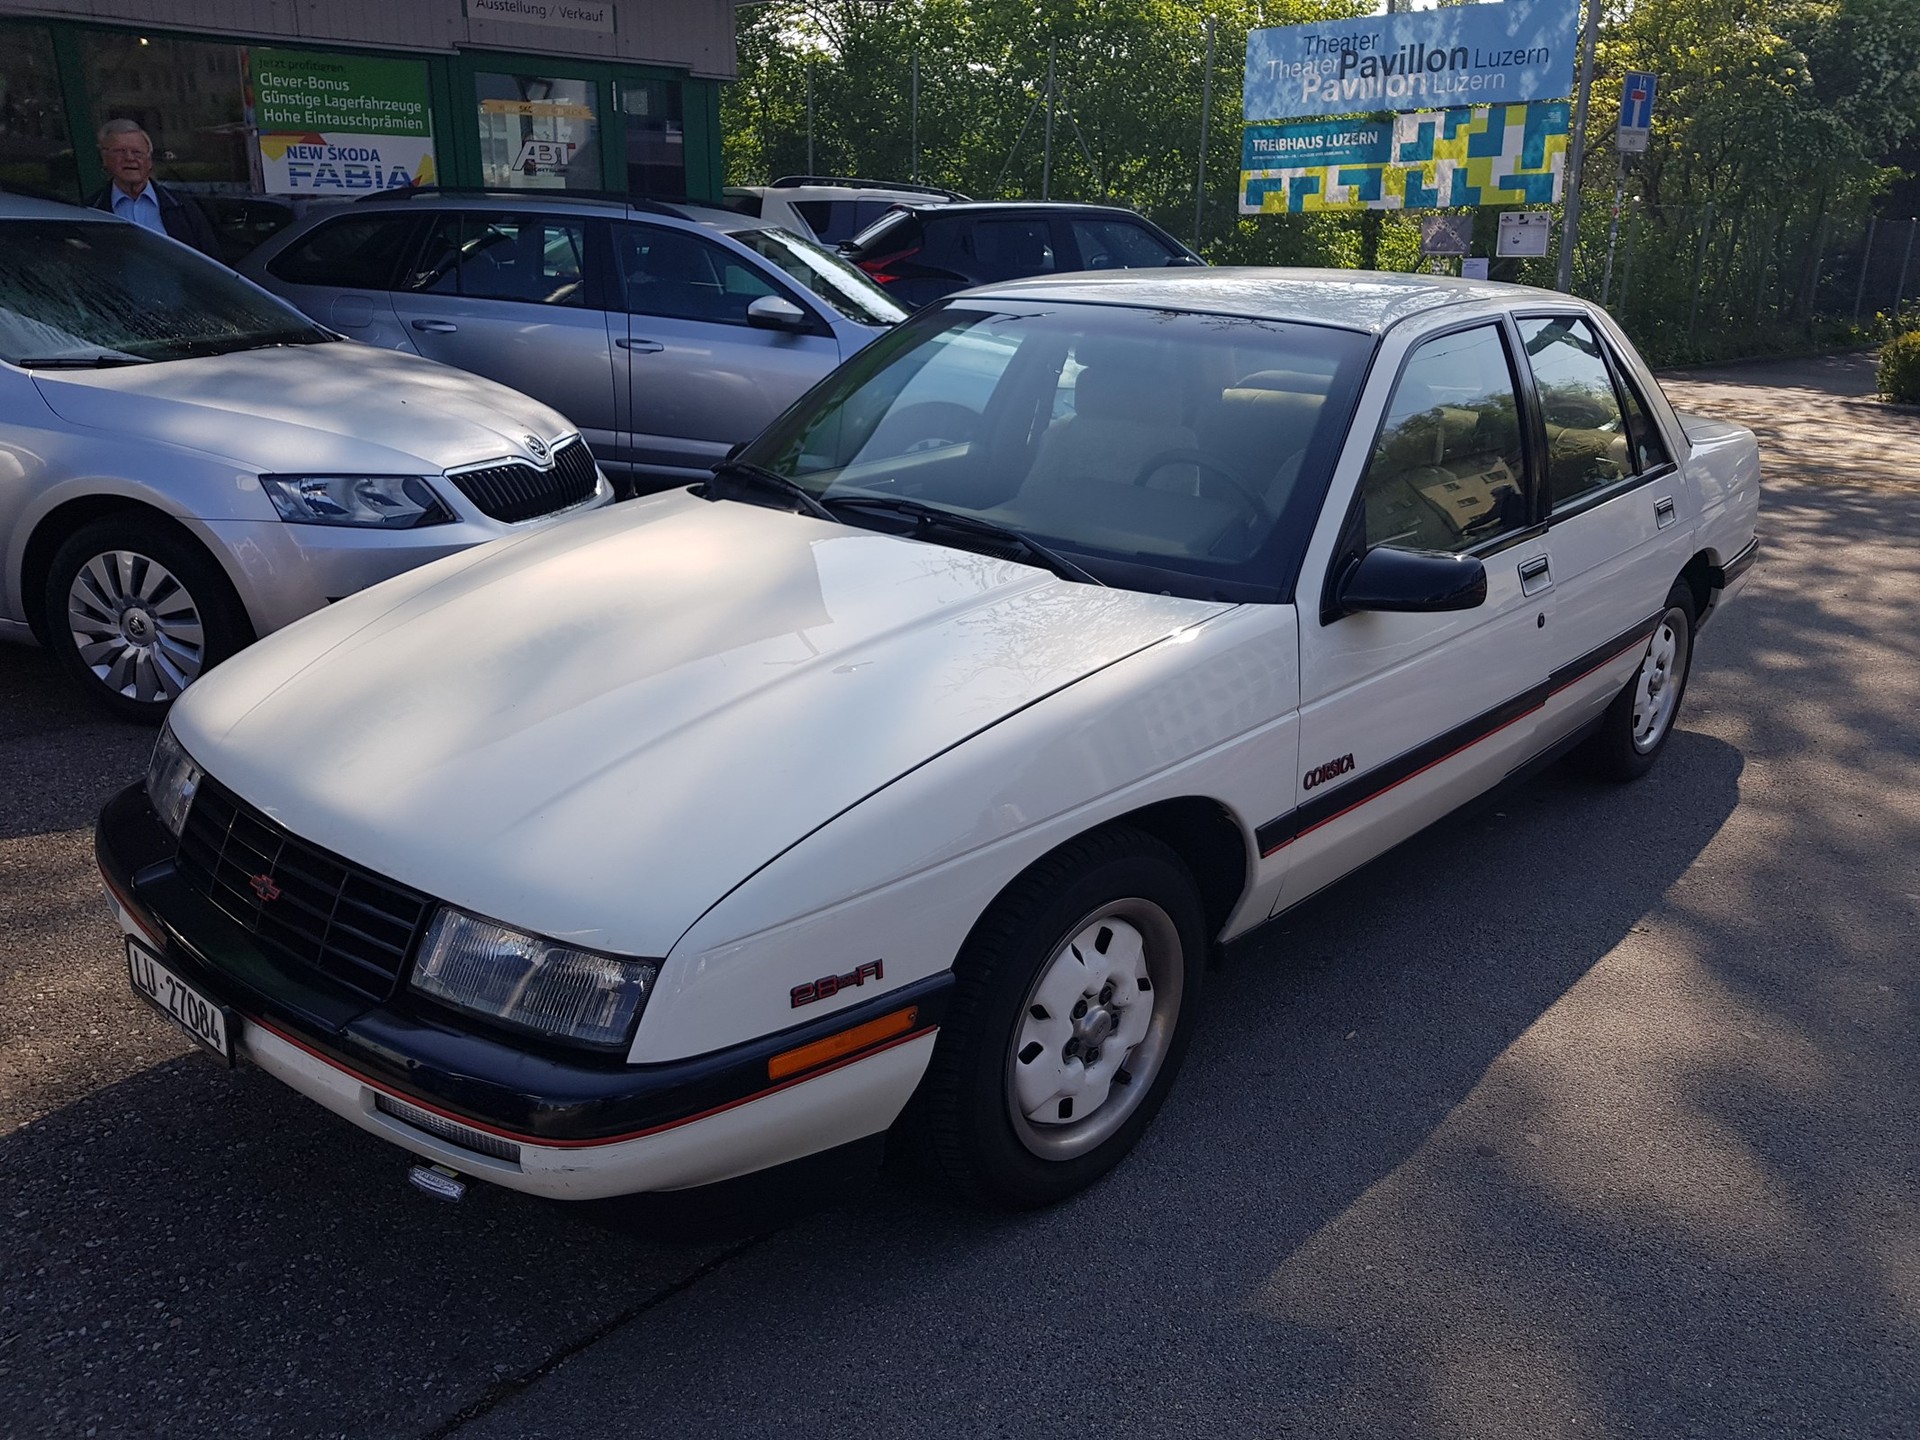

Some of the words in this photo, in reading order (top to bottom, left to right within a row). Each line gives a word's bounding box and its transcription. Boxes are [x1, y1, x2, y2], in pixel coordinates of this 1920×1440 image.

[476, 0, 546, 19] Ausstellung
[559, 7, 604, 22] Verkauf
[1304, 32, 1380, 55] Theater
[288, 60, 344, 73] profitieren
[1267, 58, 1342, 80] Theater
[1340, 43, 1469, 80] Pavillon
[1474, 47, 1549, 69] Luzern
[260, 72, 350, 92] Clever-Bonus
[1301, 69, 1427, 103] Pavillon
[1433, 72, 1505, 94] Luzern
[261, 90, 321, 109] Günstige
[324, 94, 422, 115] Lagerfahrzeuge
[264, 108, 301, 123] Hohe
[305, 111, 424, 130] Eintauschprämien
[1252, 135, 1324, 152] TREIBHAUS
[1326, 131, 1379, 148] LUZERN
[287, 145, 323, 160] NEW
[328, 144, 381, 162] ŠKODA
[512, 140, 576, 171] ABT
[288, 161, 415, 189] FABIA
[1303, 753, 1356, 790] CORSICA
